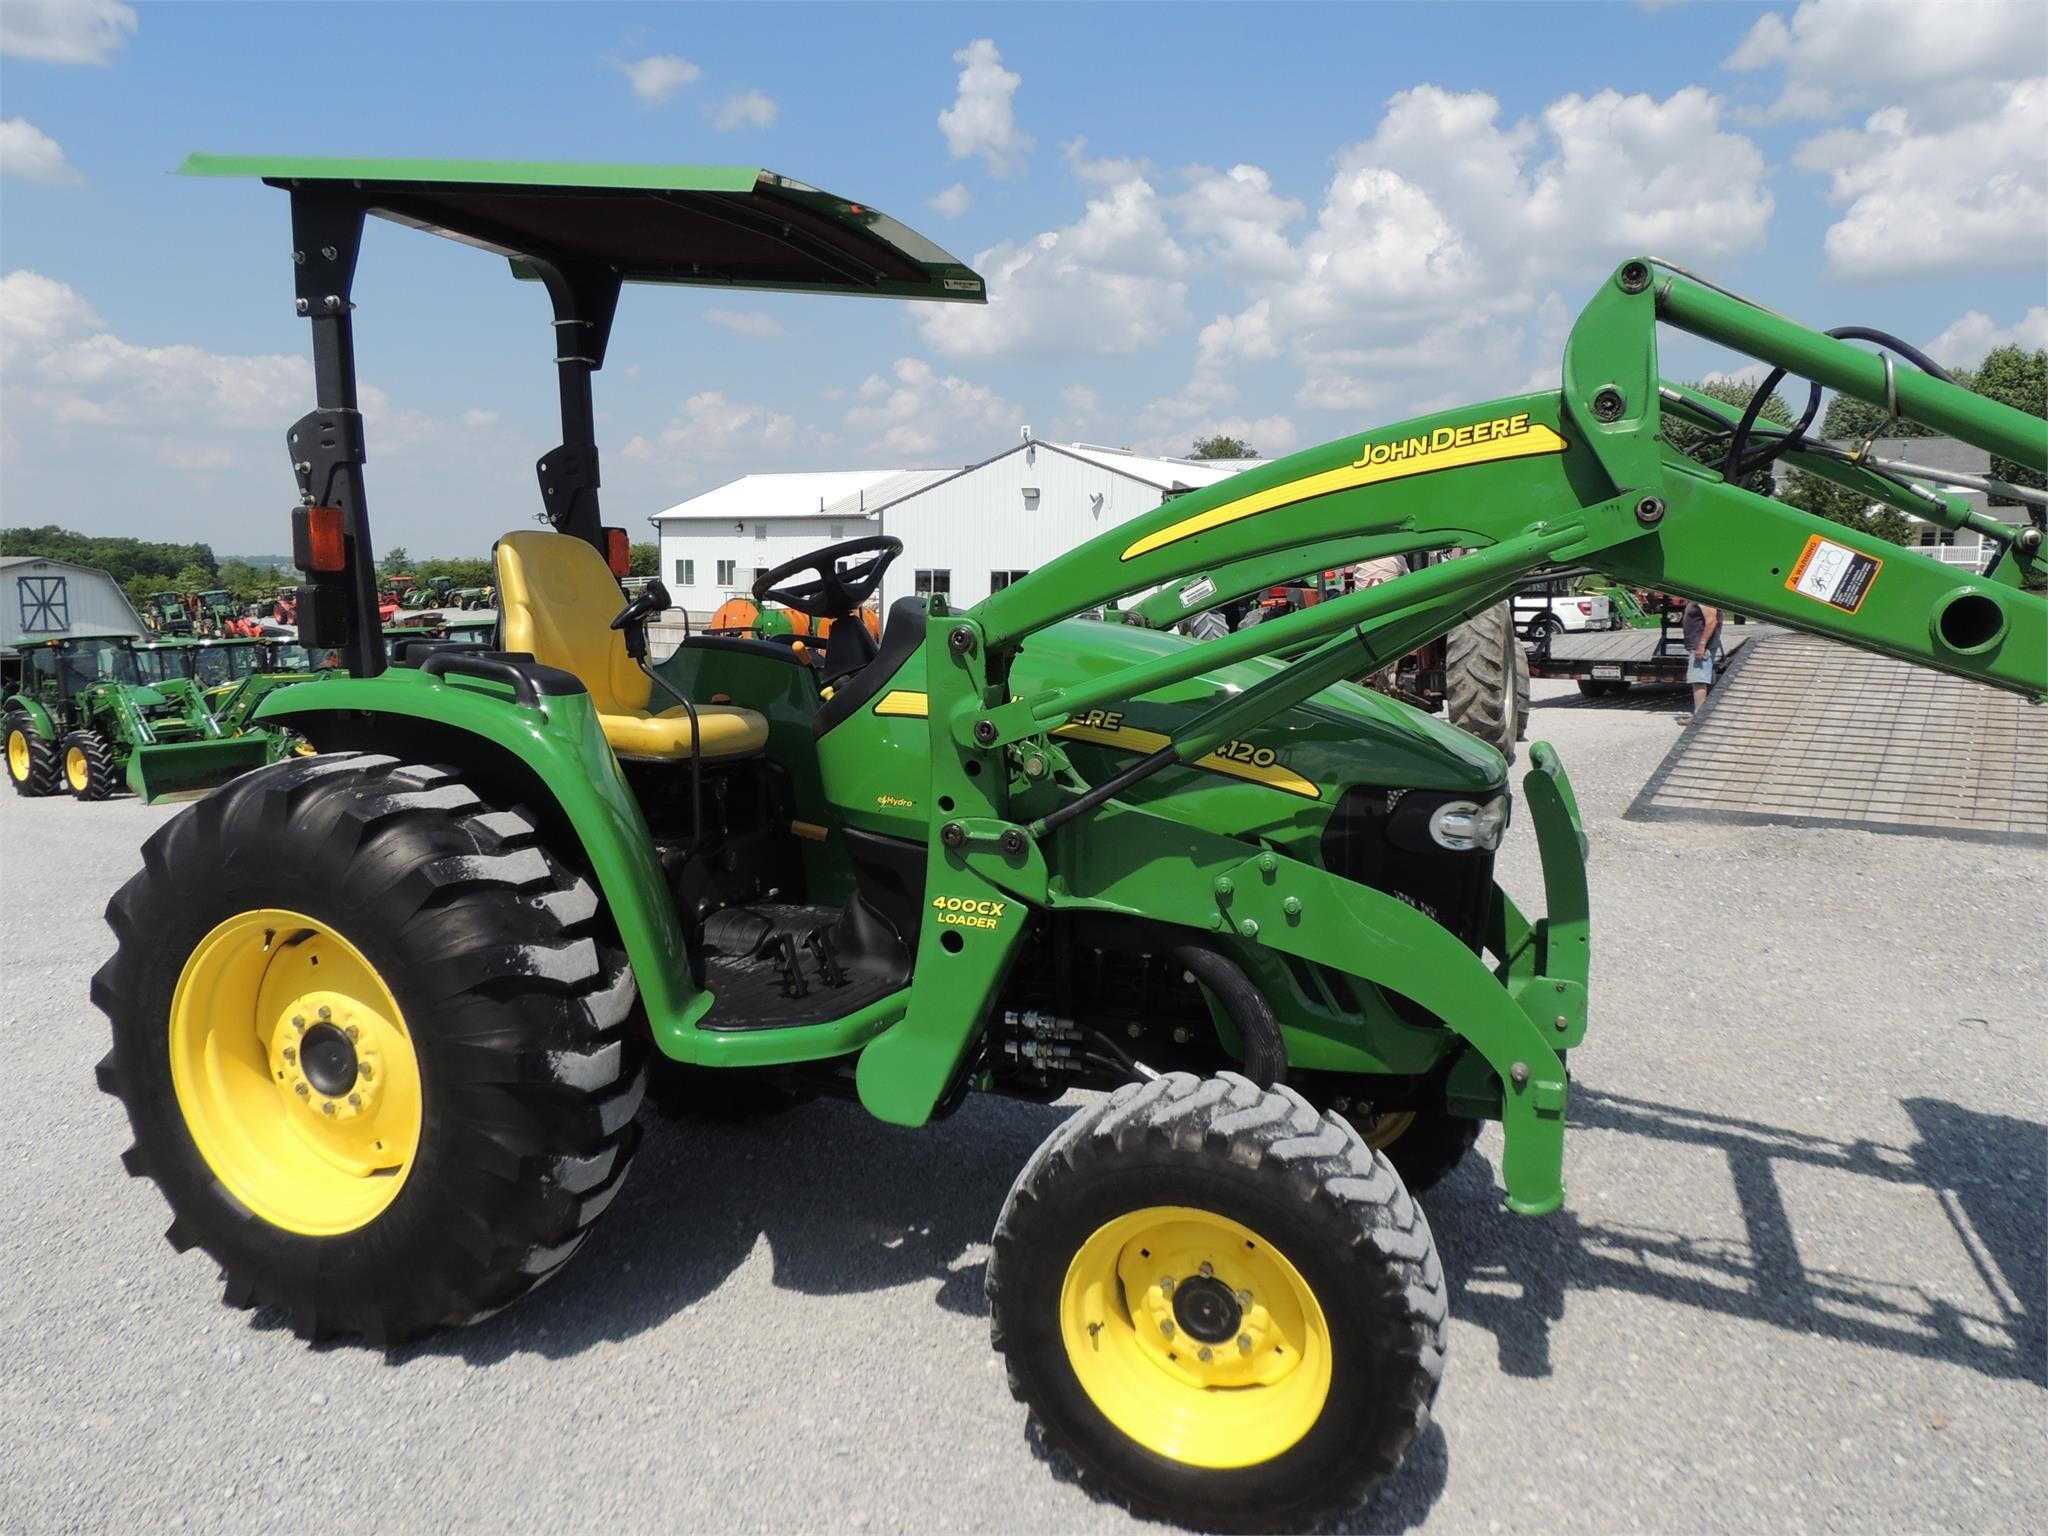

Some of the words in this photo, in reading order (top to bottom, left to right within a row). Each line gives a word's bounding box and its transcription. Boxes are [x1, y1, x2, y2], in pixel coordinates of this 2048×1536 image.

[1353, 435, 1428, 468] JOHN
[1431, 413, 1529, 452] DEERE
[1795, 543, 1817, 576] WARNING
[1071, 709, 1123, 730] ERE
[932, 896, 1005, 917] 400CX
[937, 912, 997, 930] LOADER
